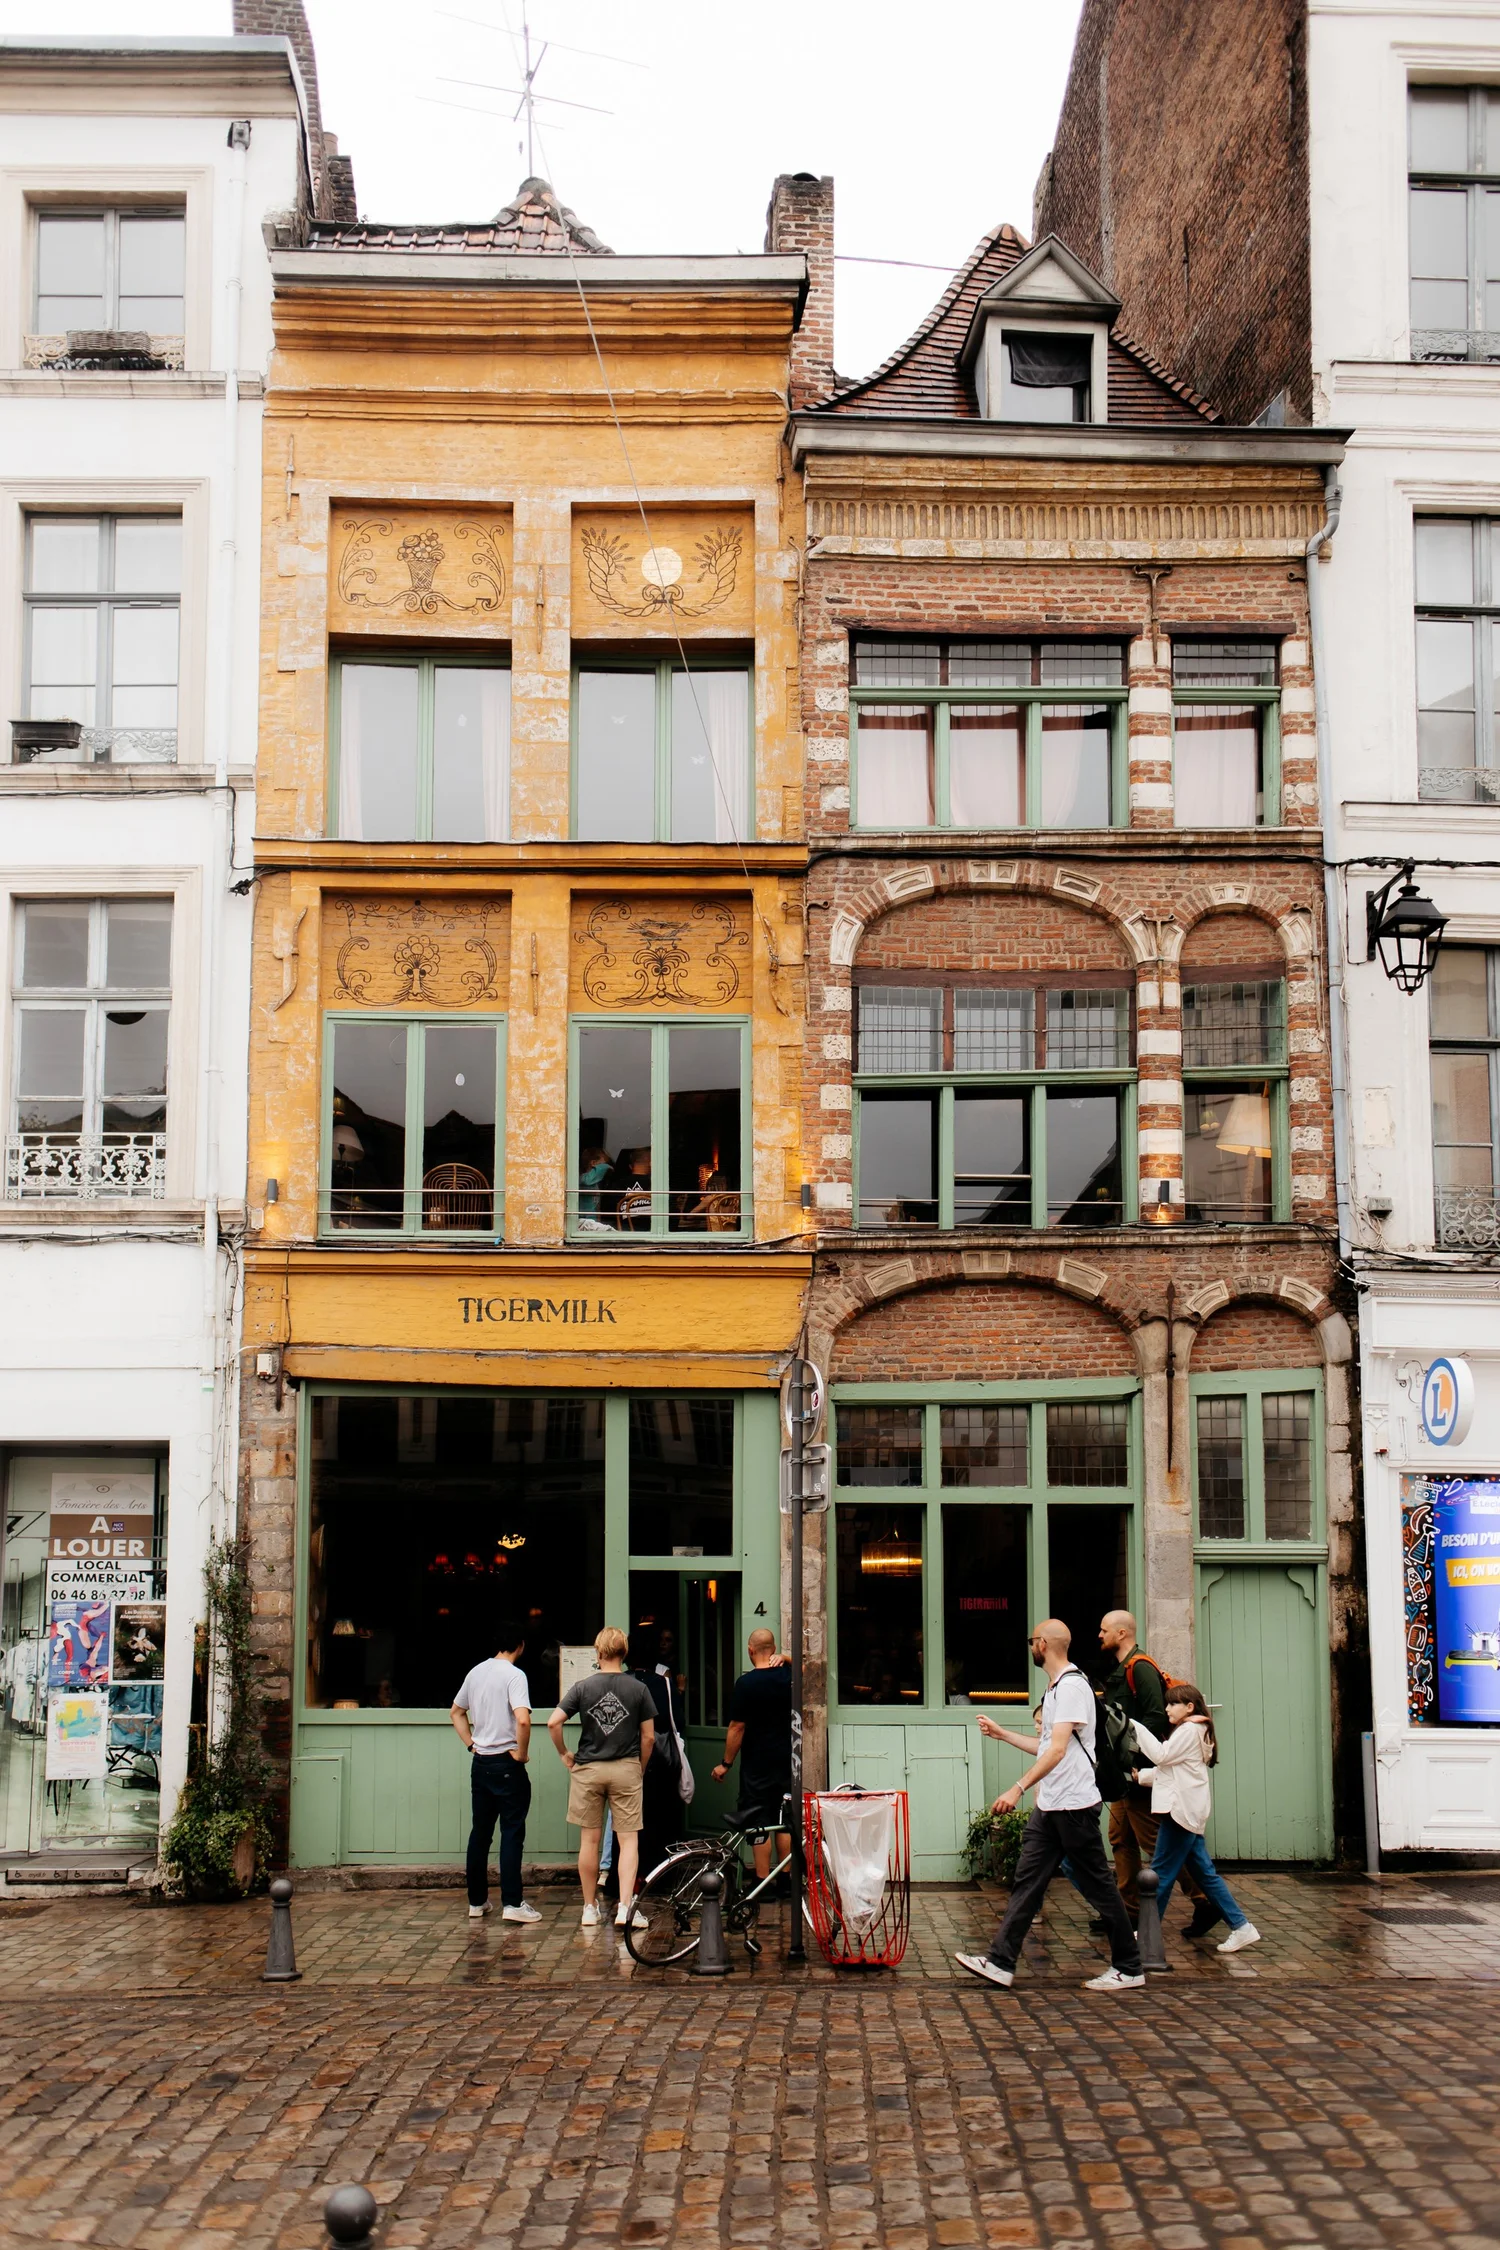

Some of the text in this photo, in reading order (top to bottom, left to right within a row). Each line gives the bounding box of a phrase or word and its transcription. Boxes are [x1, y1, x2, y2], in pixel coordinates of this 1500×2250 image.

[457, 1297, 617, 1324] TIGERMILK
[1431, 1383, 1446, 1427] L
[55, 1499, 149, 1510] Foncière des Arts
[89, 1516, 110, 1534] A
[53, 1538, 145, 1556] LOUER
[1441, 1534, 1478, 1547] BESOIN
[76, 1560, 121, 1570] LOCAL
[1470, 1565, 1485, 1577] ON
[51, 1572, 146, 1583] COMMERCIAL
[51, 1590, 66, 1600] 06
[71, 1590, 86, 1600] 46
[754, 1601, 767, 1616] 4
